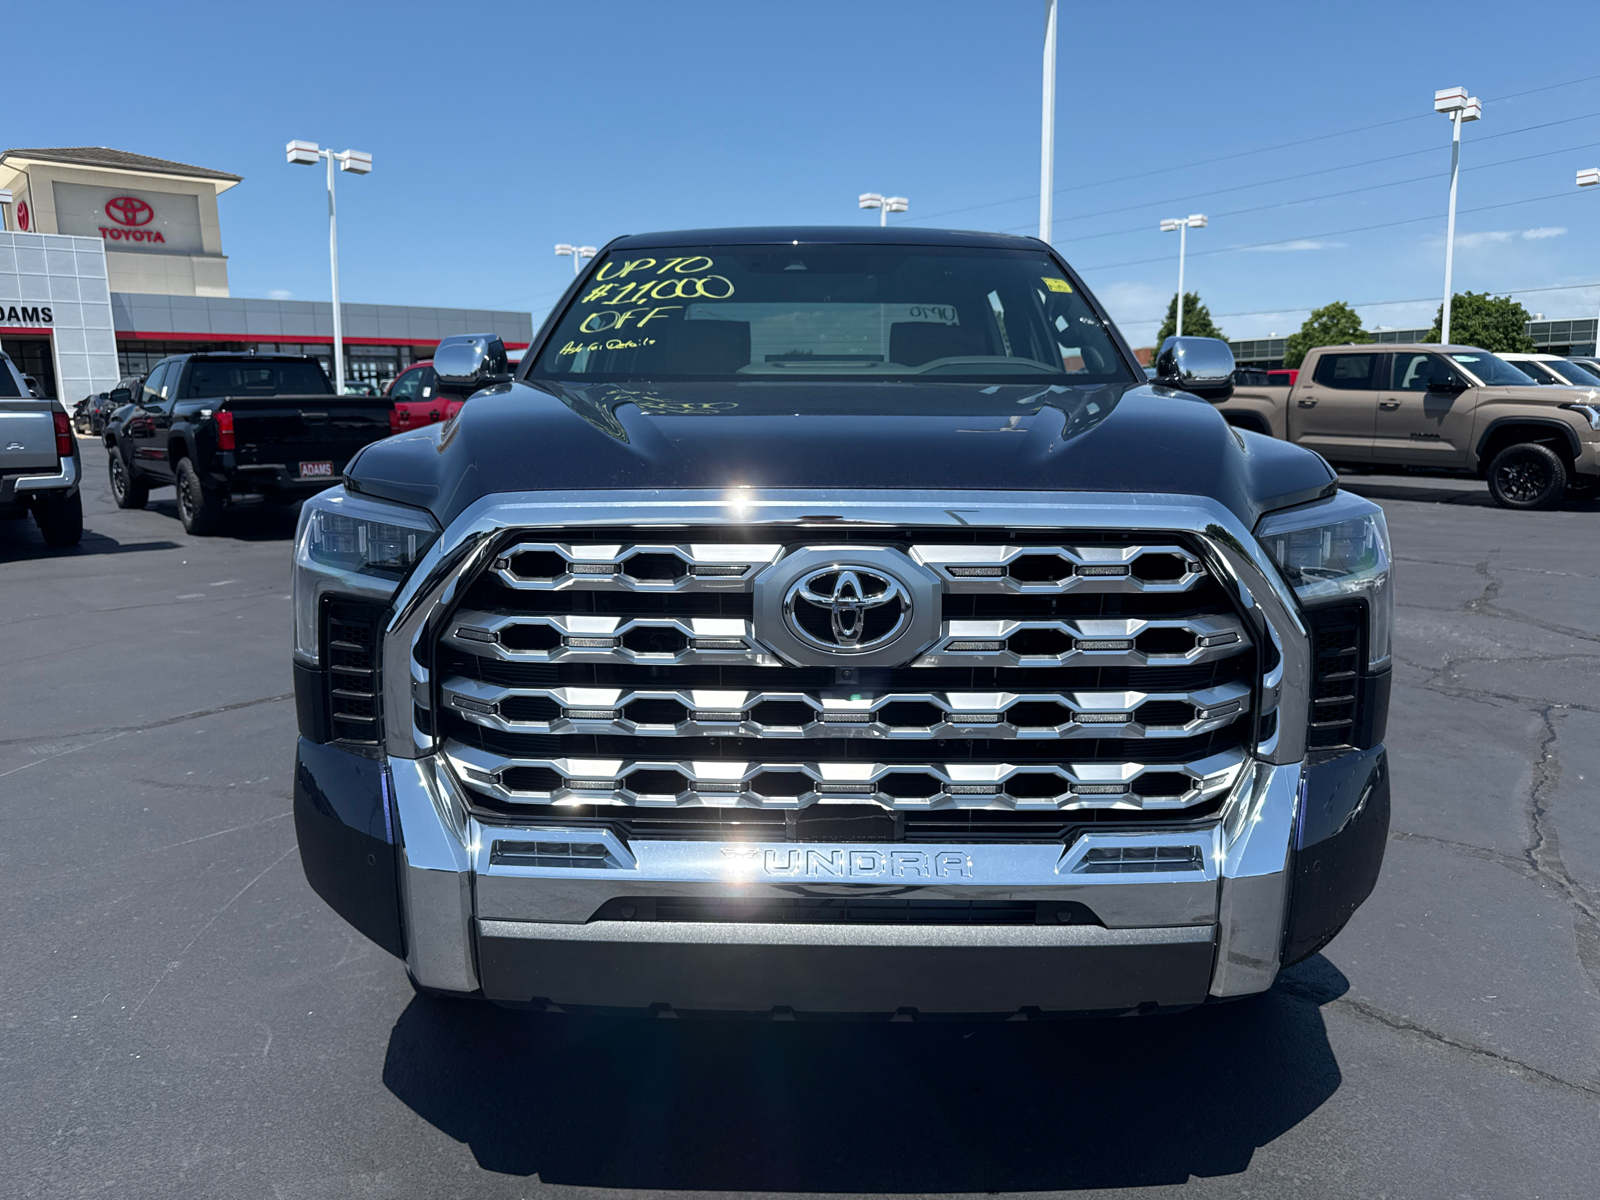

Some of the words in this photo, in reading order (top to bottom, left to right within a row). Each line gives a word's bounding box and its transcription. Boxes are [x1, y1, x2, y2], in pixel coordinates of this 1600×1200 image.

[98, 227, 165, 244] TOYOTA
[596, 258, 657, 281] UP
[657, 256, 714, 275] TO
[579, 306, 683, 333] OFF
[302, 462, 333, 477] ADAMS
[721, 847, 972, 878] TUNDRA
